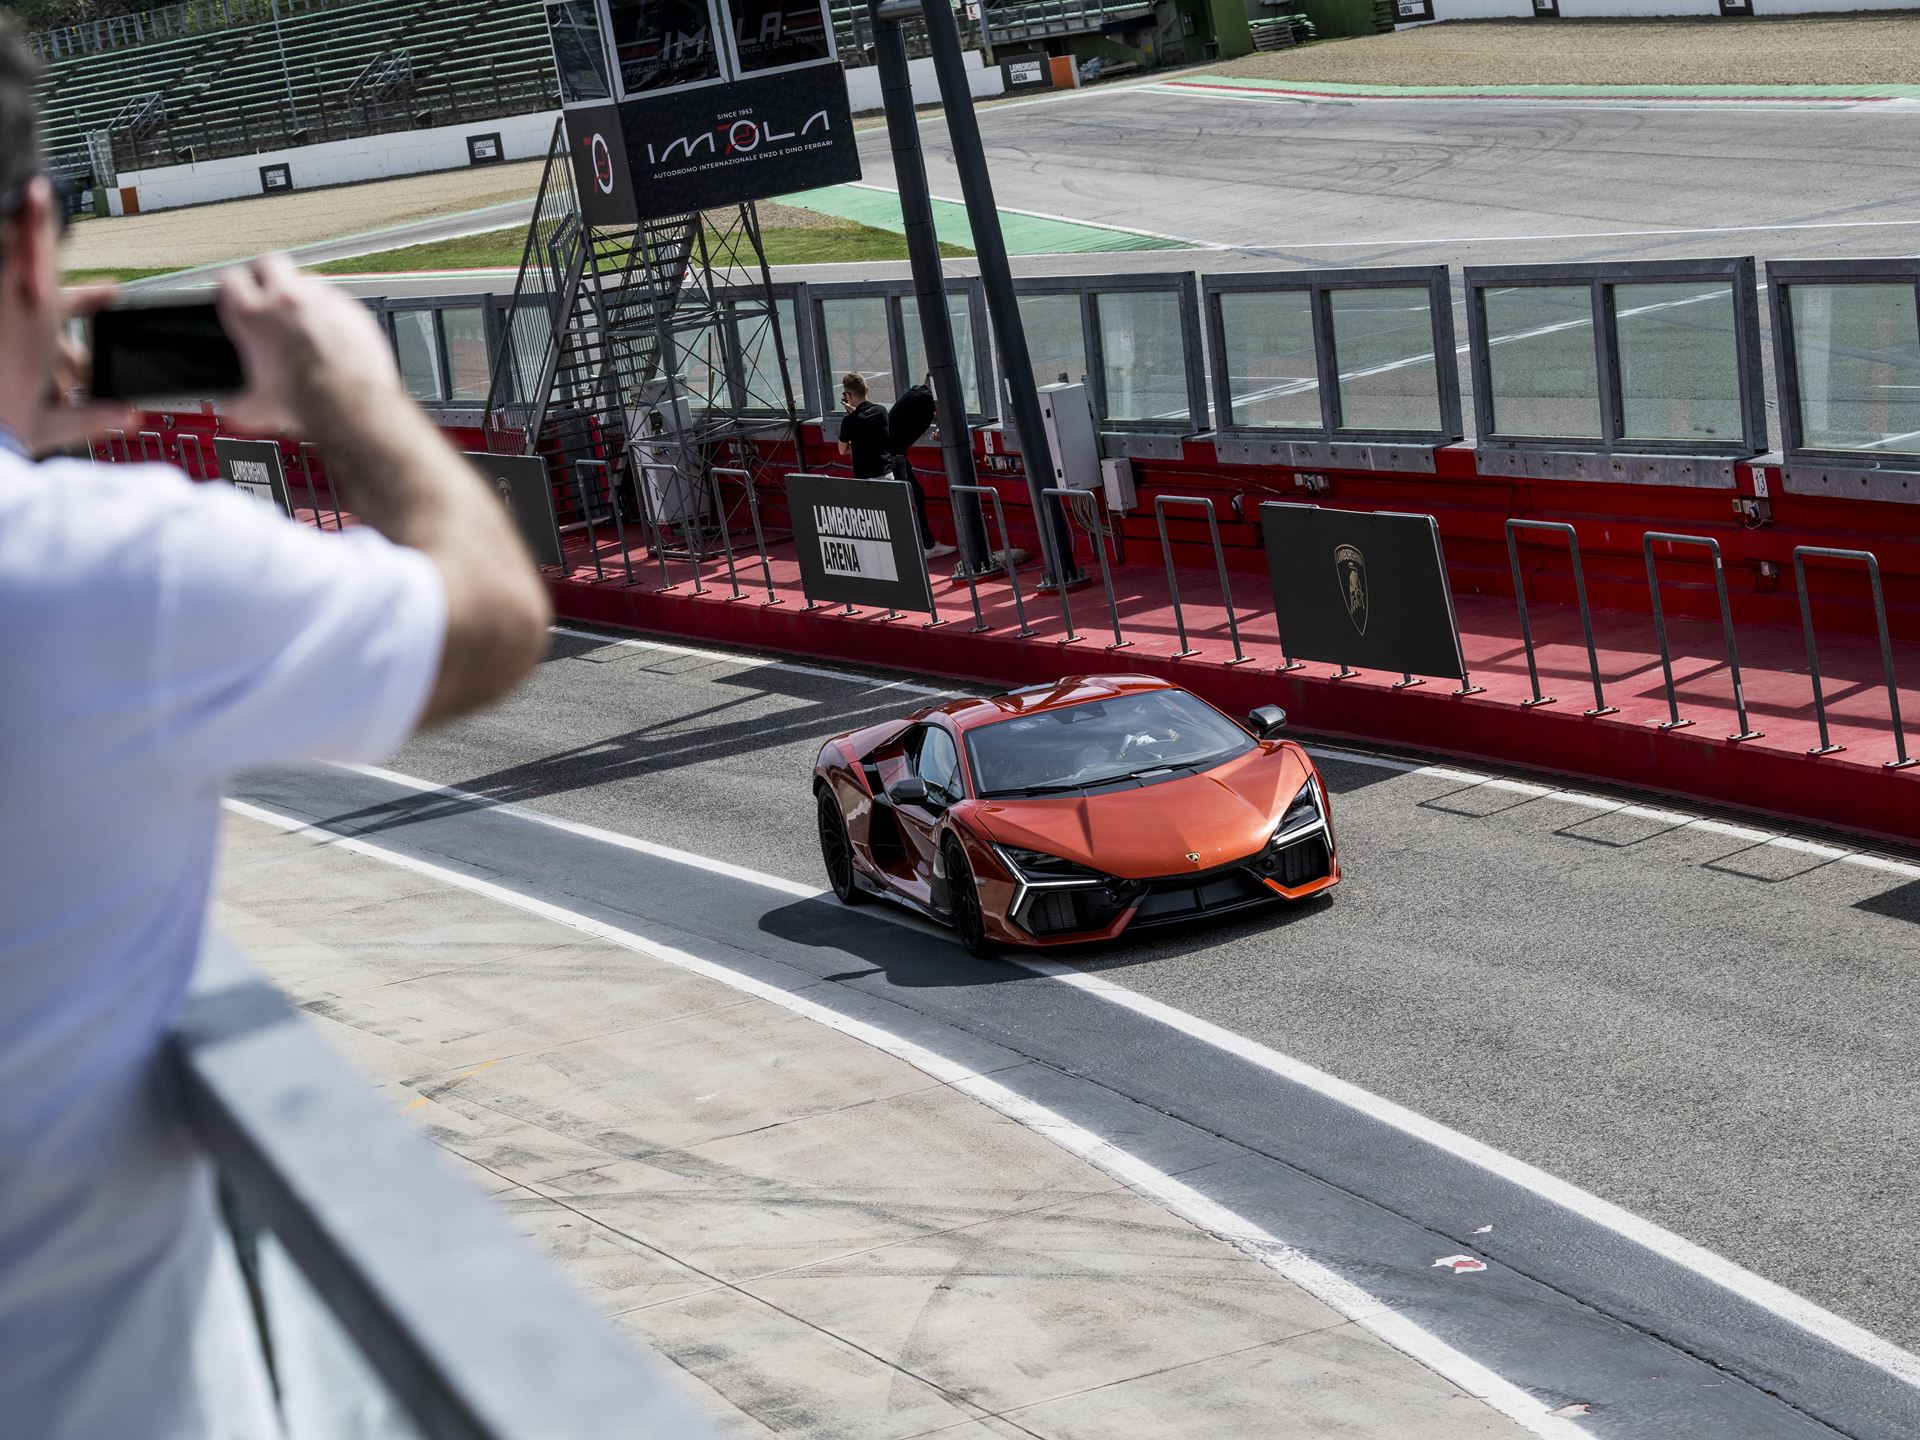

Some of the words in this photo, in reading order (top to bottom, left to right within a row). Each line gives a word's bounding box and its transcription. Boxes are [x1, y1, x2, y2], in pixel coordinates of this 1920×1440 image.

[622, 63, 667, 77] UTODROMO
[796, 33, 825, 45] FERRAR
[717, 111, 737, 120] SINCE
[739, 108, 753, 116] 1953
[647, 110, 830, 164] IMOLA
[653, 166, 698, 180] AUTODROMO
[699, 154, 758, 171] INTERNAZIONALE
[759, 150, 778, 160] ENZO
[785, 146, 803, 154] DINO
[804, 140, 833, 151] FERRARI
[1755, 473, 1766, 491] 13
[813, 505, 890, 539] LAMBORGHINI
[823, 541, 861, 572] ARENA
